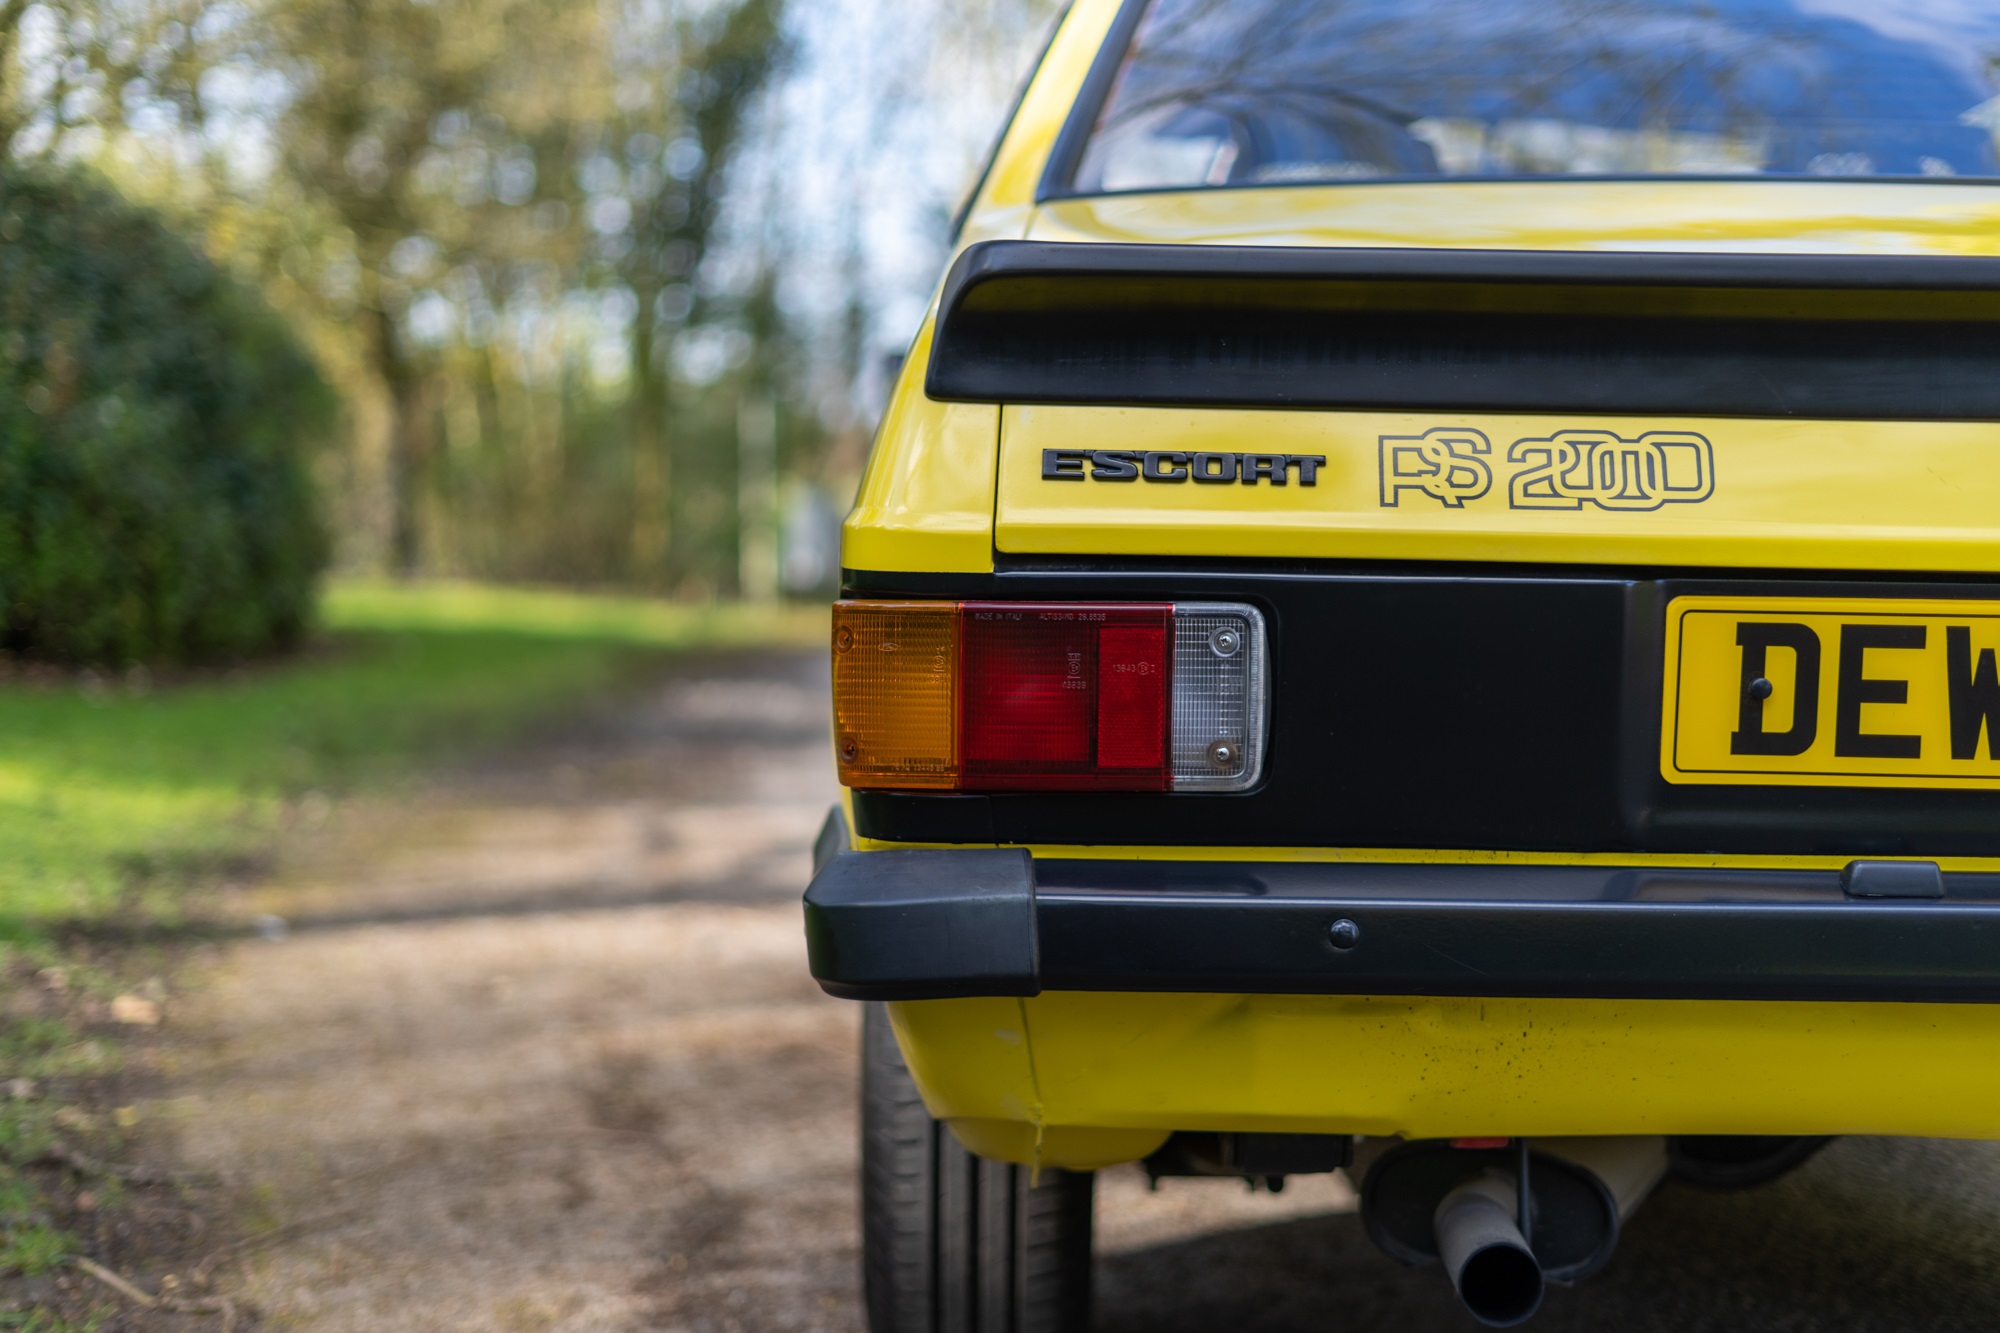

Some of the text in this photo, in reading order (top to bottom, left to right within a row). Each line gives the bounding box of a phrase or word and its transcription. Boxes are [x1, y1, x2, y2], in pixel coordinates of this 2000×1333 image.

[1041, 448, 1326, 487] ESCORT
[1378, 427, 1491, 509] RS
[975, 612, 1023, 621] MADE IN ITALY
